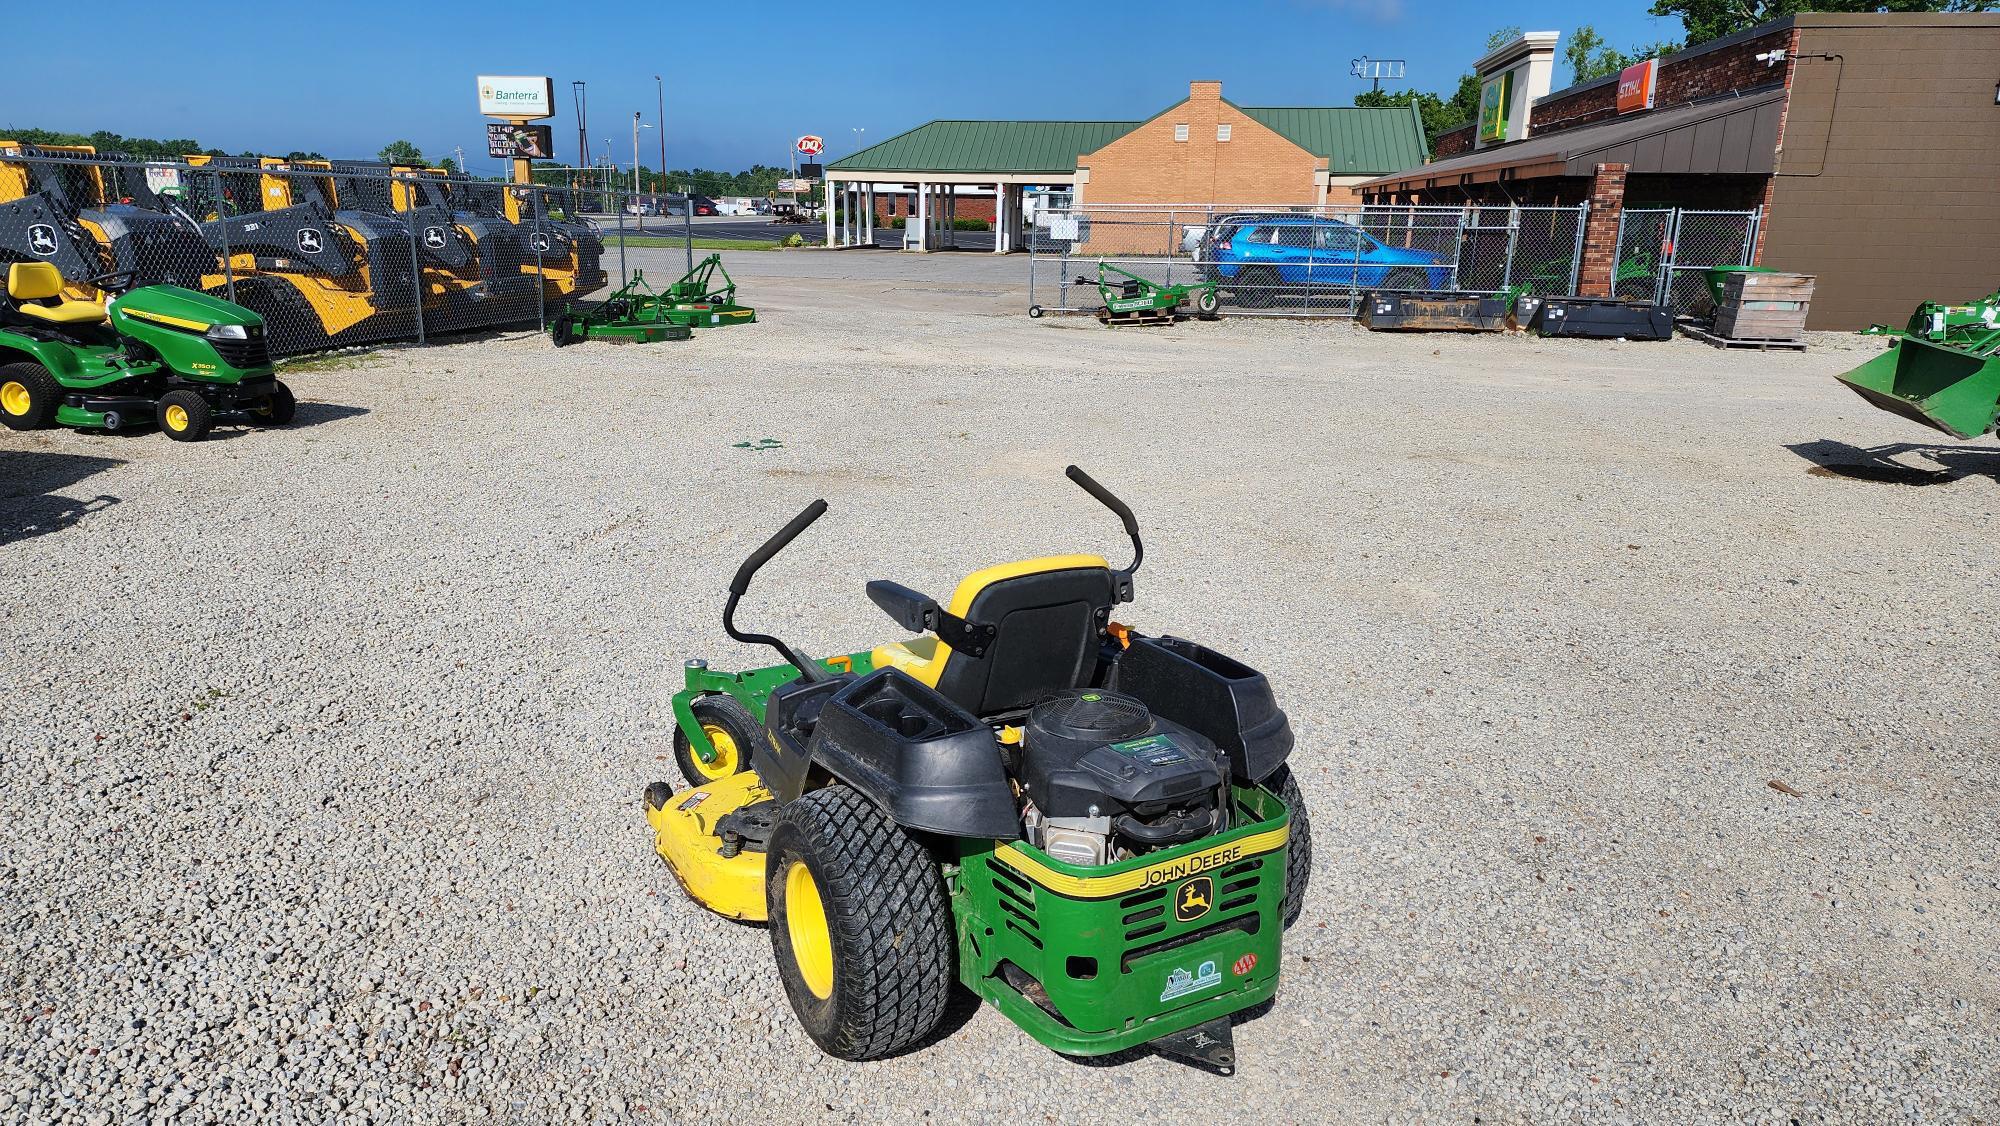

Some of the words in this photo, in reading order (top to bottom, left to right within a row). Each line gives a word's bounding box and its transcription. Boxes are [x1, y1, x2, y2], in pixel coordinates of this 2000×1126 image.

[495, 90, 538, 100] Banterra
[1620, 79, 1641, 99] STIHL
[801, 140, 819, 151] DQ
[1140, 863, 1186, 888] JOHN
[1190, 846, 1242, 873] DEERE
